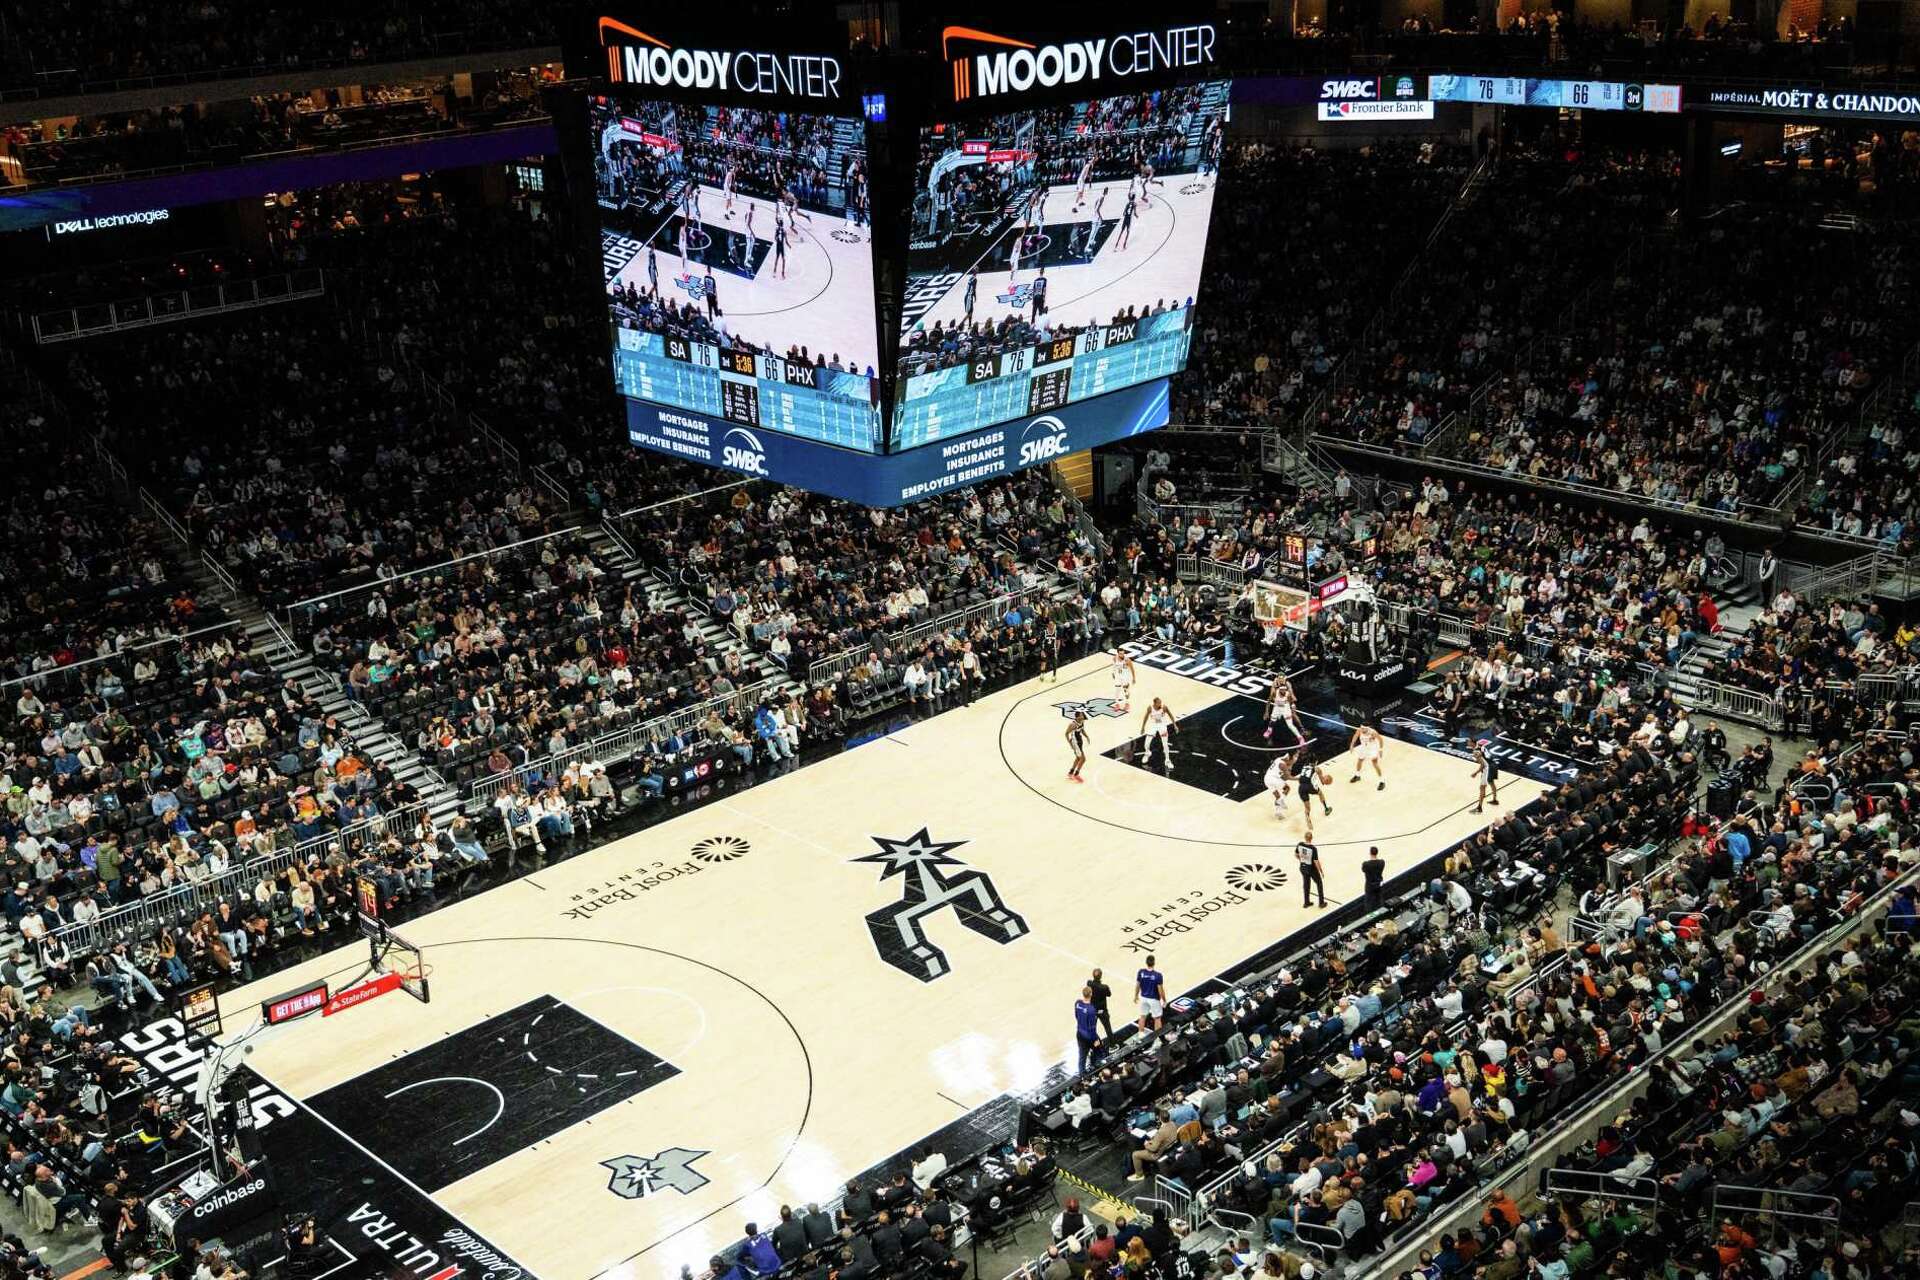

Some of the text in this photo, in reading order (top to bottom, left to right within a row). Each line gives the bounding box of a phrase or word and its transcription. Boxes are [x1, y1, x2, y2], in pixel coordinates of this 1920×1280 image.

[624, 45, 840, 98] MOODY CENTER
[977, 24, 1216, 96] MOODY CENTER
[1320, 80, 1374, 98] SWBC
[1479, 79, 1493, 100] 76
[1573, 84, 1588, 105] 66
[1627, 91, 1640, 104] 3rd
[1711, 89, 1920, 114] IMPÉRIAL MOËT & CHANDON
[1351, 100, 1424, 113] Frontier Bank
[56, 208, 169, 234] DELL Technologies
[669, 341, 687, 359] SA
[698, 344, 711, 367] 76
[734, 354, 753, 374] 5:36
[764, 357, 778, 381] 66
[787, 364, 815, 386] PHX
[974, 361, 994, 379] SA
[1010, 350, 1024, 373] 76
[1052, 340, 1073, 360] 5:36
[1085, 331, 1099, 354] 66
[1108, 323, 1136, 345] PHX
[658, 411, 709, 433] MORTGAGES
[662, 426, 710, 446] INSURANCE
[629, 430, 711, 461] EMPLOYEE BENEFITS
[722, 446, 766, 475] SWBC
[943, 431, 1005, 458] MORTGAGES
[946, 445, 1005, 471] INSURANCE
[1018, 433, 1069, 466] SWBC
[901, 460, 1005, 499] EMPLOYEE BENEFITS
[1107, 641, 1274, 696] SPURS
[1373, 662, 1404, 682] coinbase
[1489, 744, 1581, 779] ULTRA
[559, 861, 704, 919] Frost Bank
[570, 861, 664, 901] CENTER
[1120, 890, 1203, 932] CENTER
[1120, 890, 1249, 953] Frost Bank
[276, 1004, 290, 1018] GET
[341, 986, 378, 1005] State Farm
[119, 1011, 298, 1131] SRS
[193, 1178, 266, 1218] coinbase
[346, 1202, 440, 1275] ULTRA
[438, 1228, 522, 1280] Courtside
